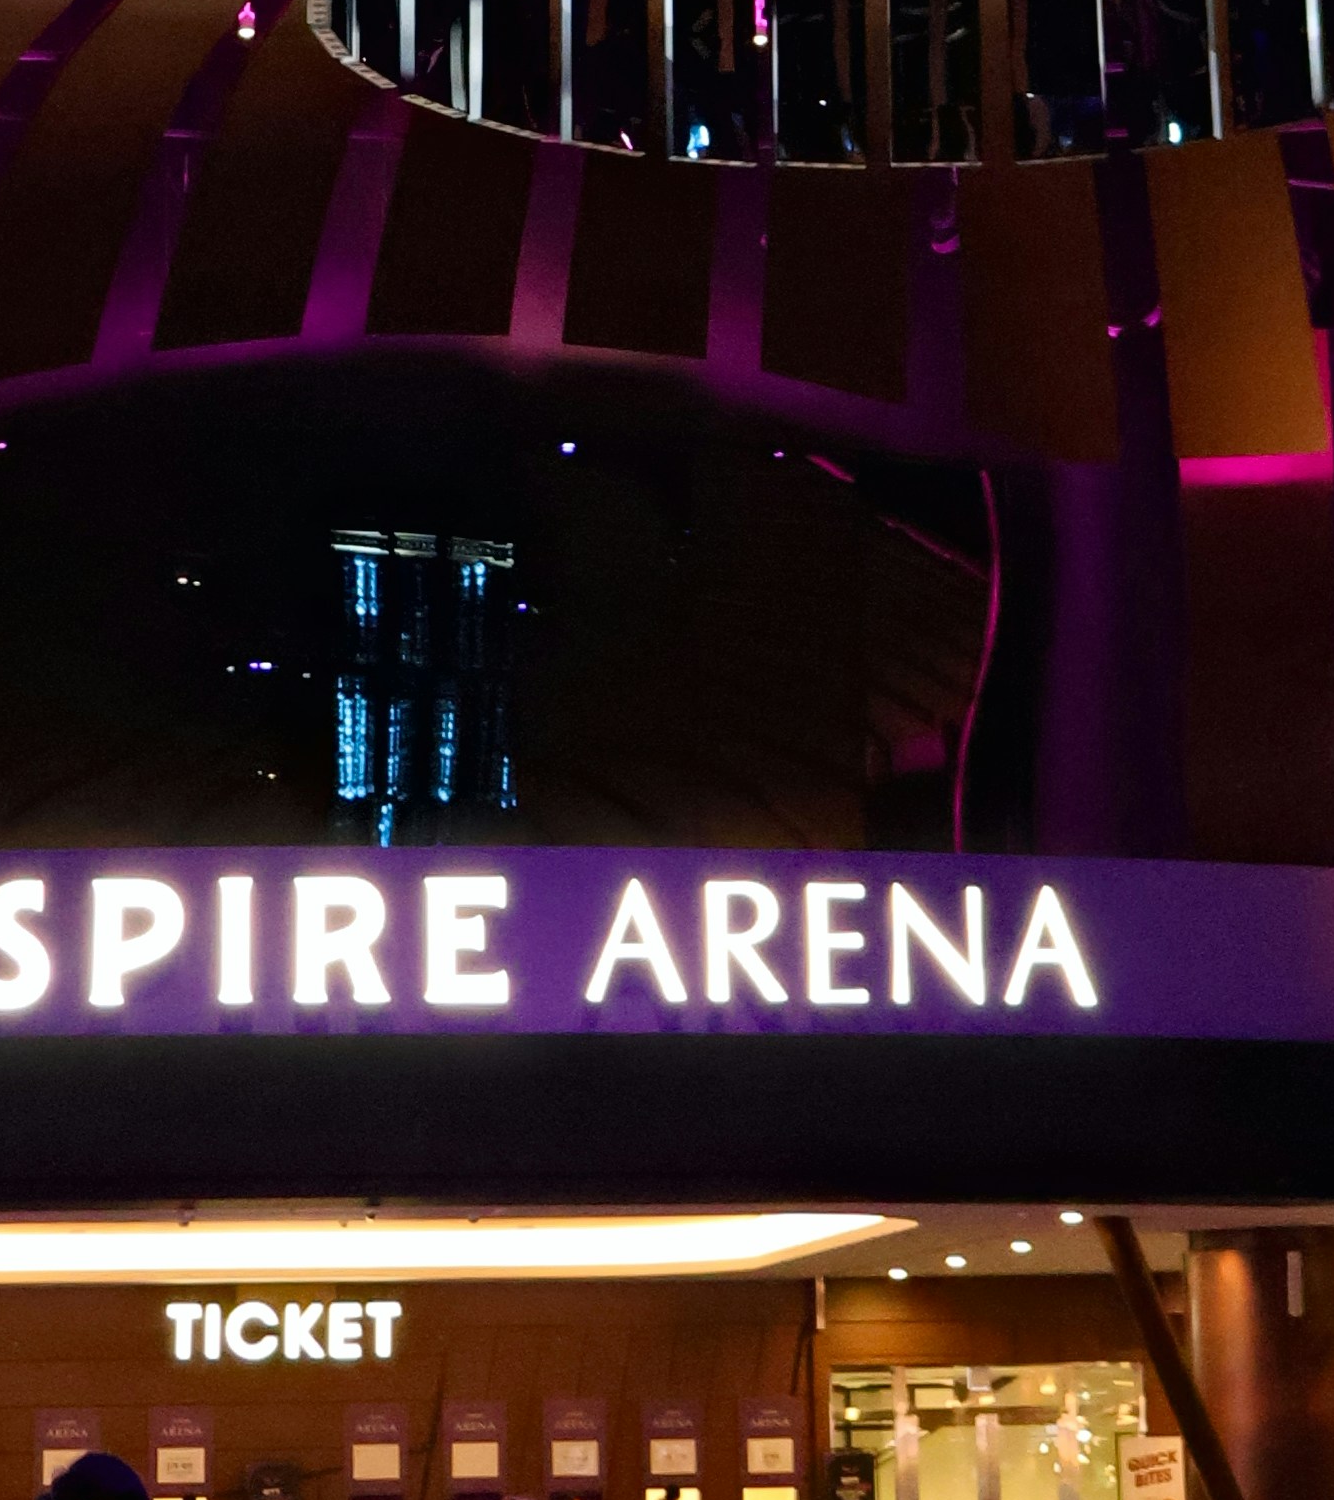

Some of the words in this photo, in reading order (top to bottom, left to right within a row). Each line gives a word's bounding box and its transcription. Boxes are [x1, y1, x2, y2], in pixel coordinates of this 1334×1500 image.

[583, 874, 1099, 1012] ARENA
[163, 1300, 403, 1361] TICKET
[1127, 1451, 1178, 1472] QUICK
[1133, 1468, 1173, 1488] BITES
